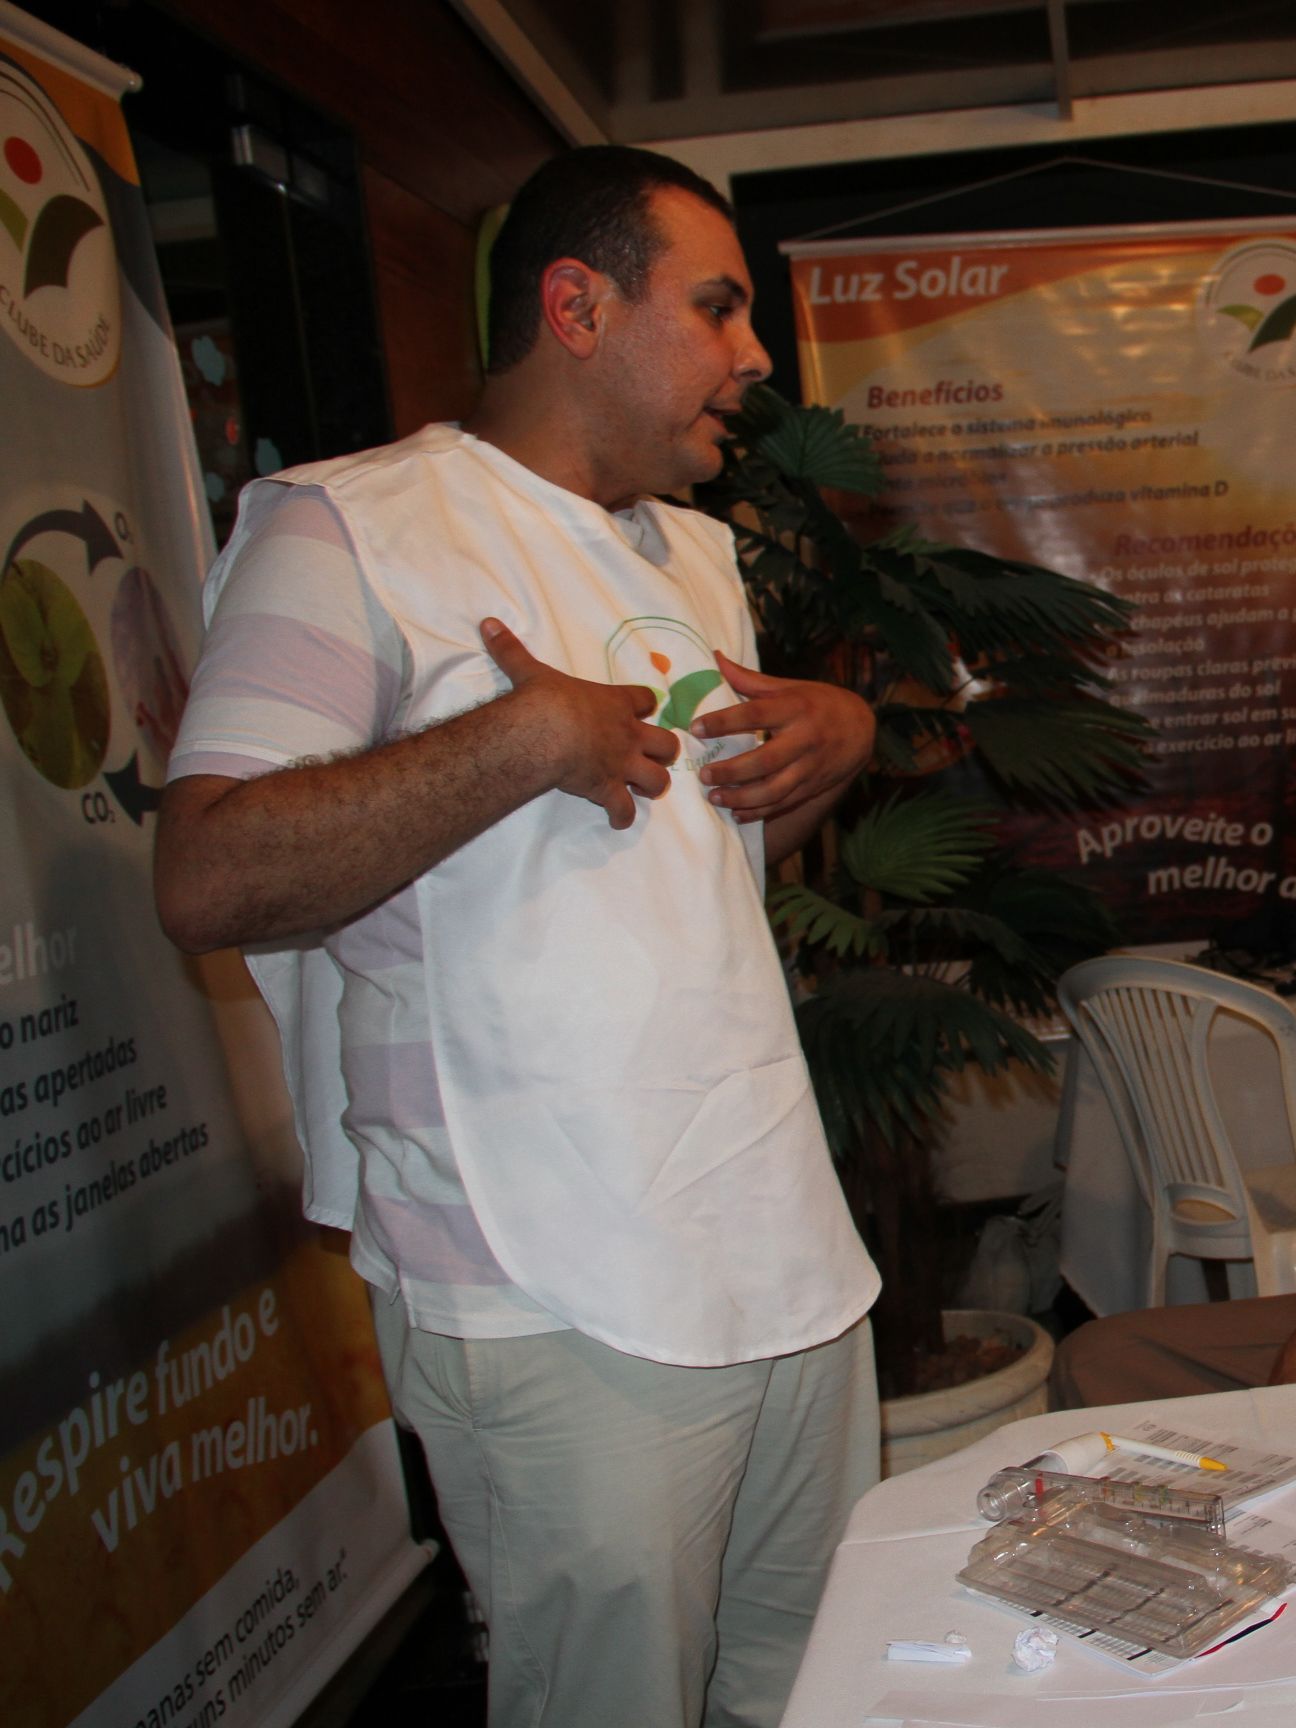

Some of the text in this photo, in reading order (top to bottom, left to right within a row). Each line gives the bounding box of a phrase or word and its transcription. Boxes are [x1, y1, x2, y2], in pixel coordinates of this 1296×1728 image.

[810, 255, 1010, 305] Luz Solar
[51, 341, 77, 368] DA
[867, 379, 1004, 410] Benefícios
[863, 421, 946, 442] Fortalece
[1131, 429, 1200, 451] arterial
[1129, 484, 1211, 501] vitamina
[1214, 479, 1230, 498] D
[1127, 558, 1184, 582] óculos
[1187, 559, 1209, 578] de
[1213, 558, 1239, 576] sol
[1186, 583, 1271, 602] cataratas
[1206, 607, 1274, 630] ajudam
[1277, 609, 1290, 623] a
[1131, 663, 1193, 683] roupas
[1197, 659, 1249, 677] claras
[1228, 681, 1253, 698] do
[1256, 679, 1282, 696] sol
[1164, 710, 1220, 730] entrar
[1223, 706, 1248, 724] sol
[1251, 709, 1279, 723] em
[1156, 731, 1235, 754] exercício
[1237, 733, 1261, 749] ao
[1263, 731, 1283, 747] ar
[1074, 812, 1275, 866] Aproveite o
[1147, 855, 1277, 897] melhor
[20, 992, 79, 1043] nariz
[0, 1036, 138, 1116] as apertadas
[0, 1083, 168, 1182] cícios ao ar livre
[32, 1200, 61, 1237] as
[65, 1160, 137, 1233] janelas
[139, 1123, 210, 1180] abertas
[155, 1304, 257, 1416] fundo
[258, 1287, 280, 1338] e
[91, 1396, 319, 1553] viva melhor.
[195, 1632, 235, 1688] sem
[234, 1567, 300, 1645] comida,
[184, 1689, 227, 1728] uns
[227, 1615, 295, 1703] minutos
[296, 1581, 327, 1629] sem
